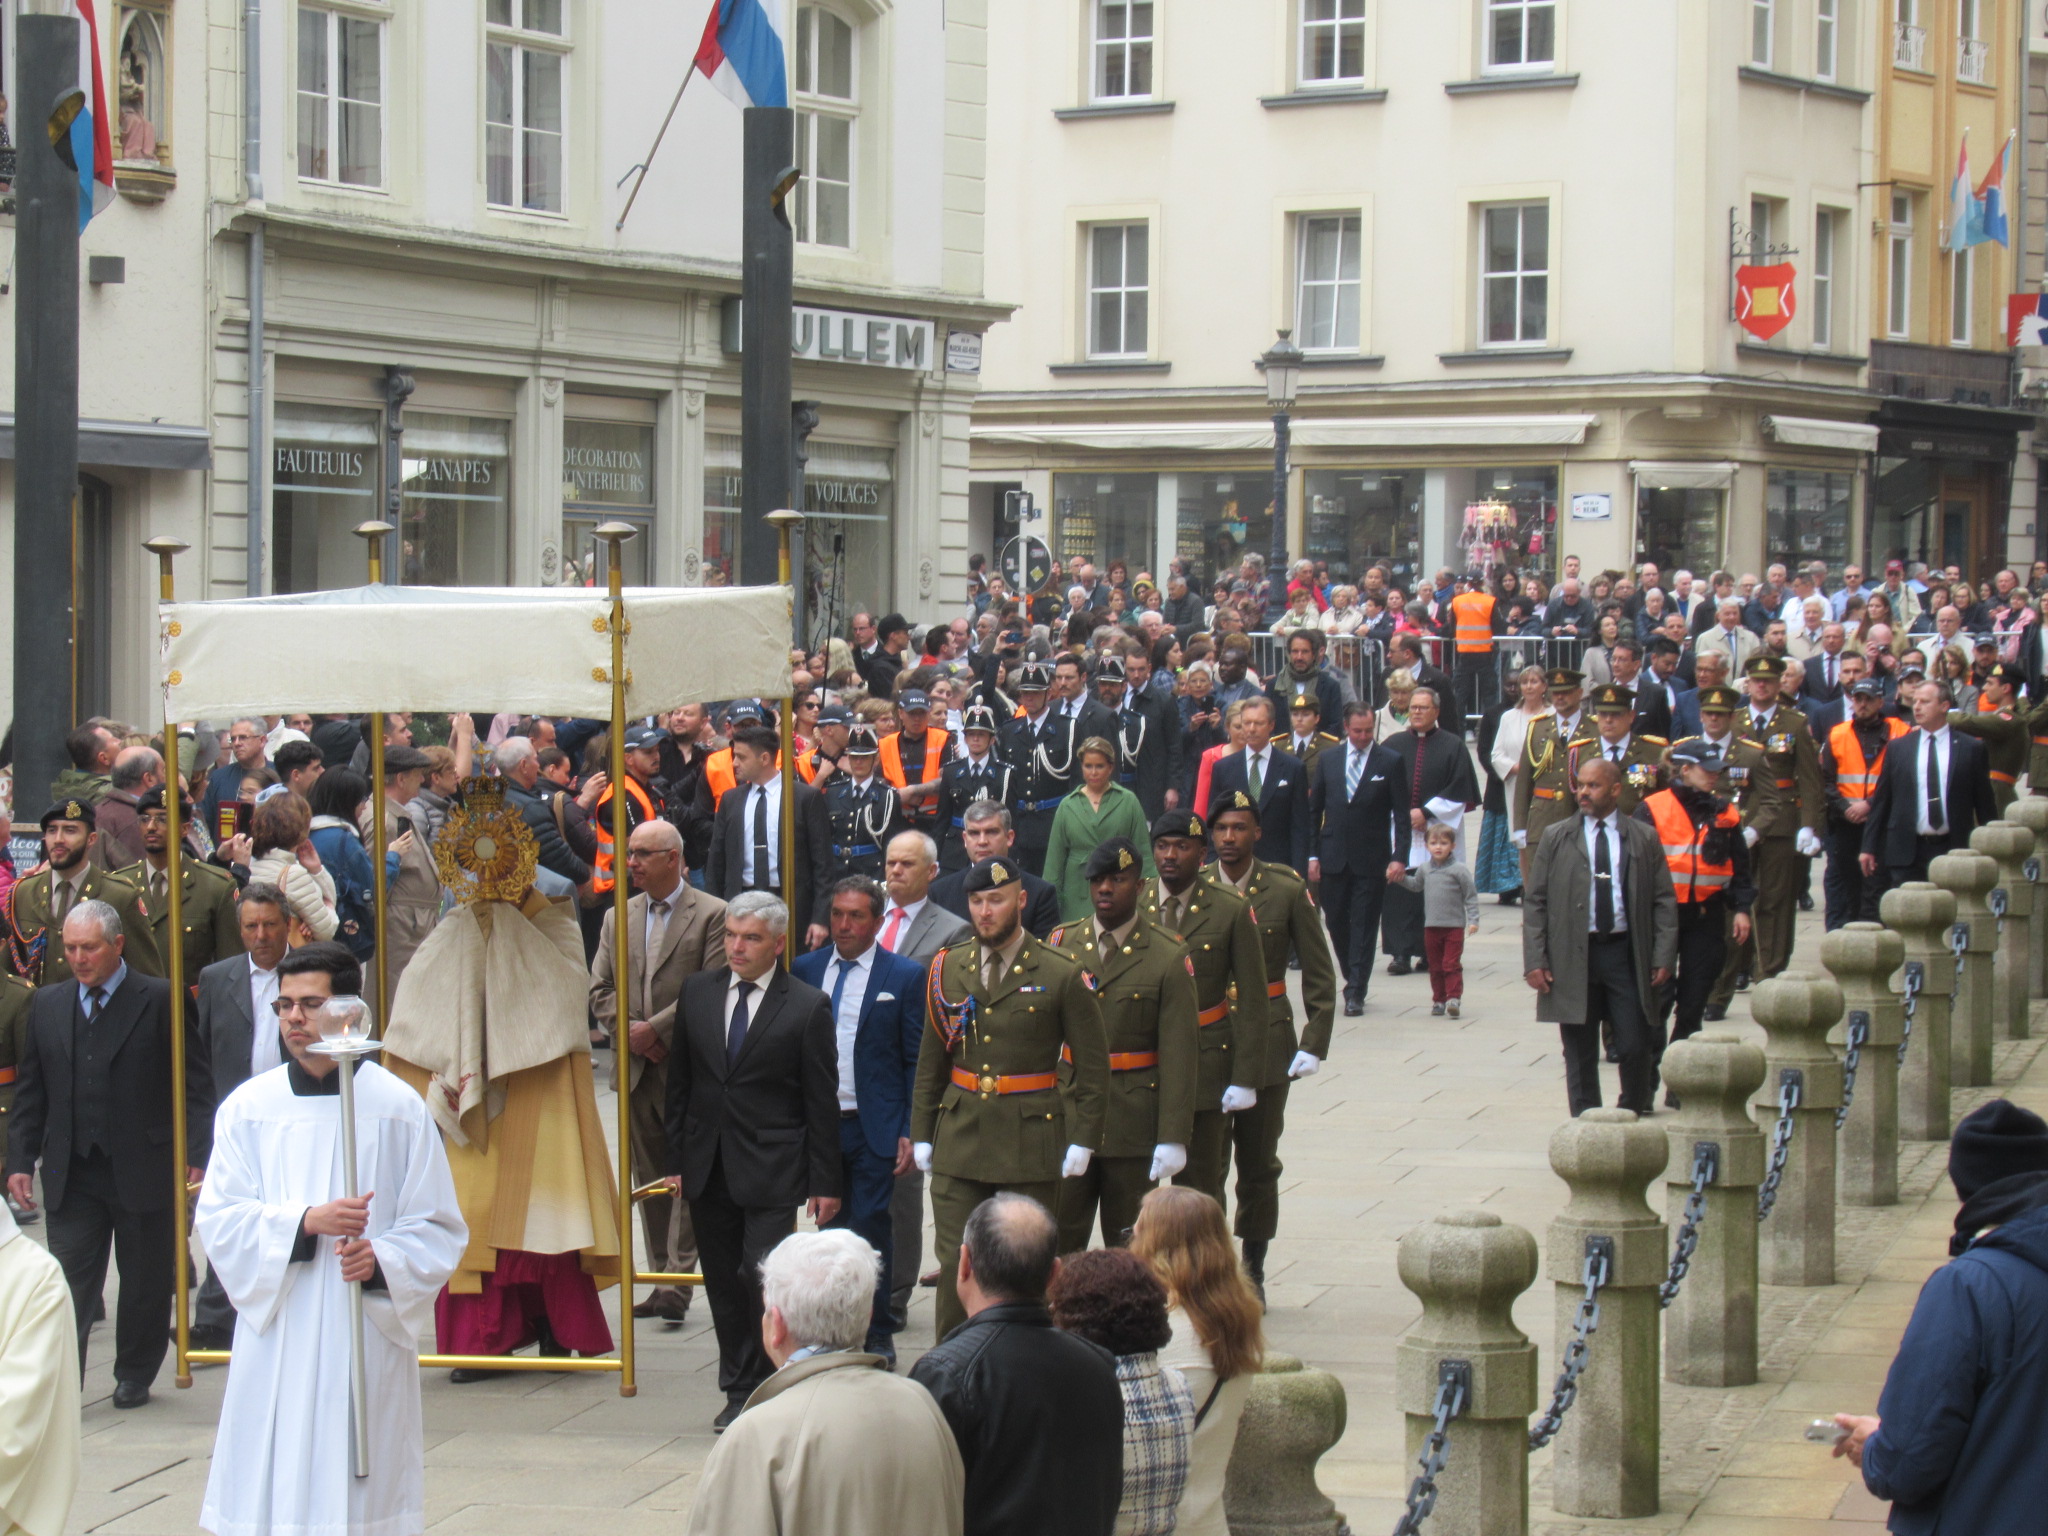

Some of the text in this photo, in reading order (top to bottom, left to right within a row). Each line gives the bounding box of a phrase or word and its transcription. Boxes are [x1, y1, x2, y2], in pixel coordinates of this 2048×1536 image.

[792, 312, 925, 367] ULLEM
[277, 448, 362, 477] FAUTEUILS
[815, 480, 878, 504] VOILAGES
